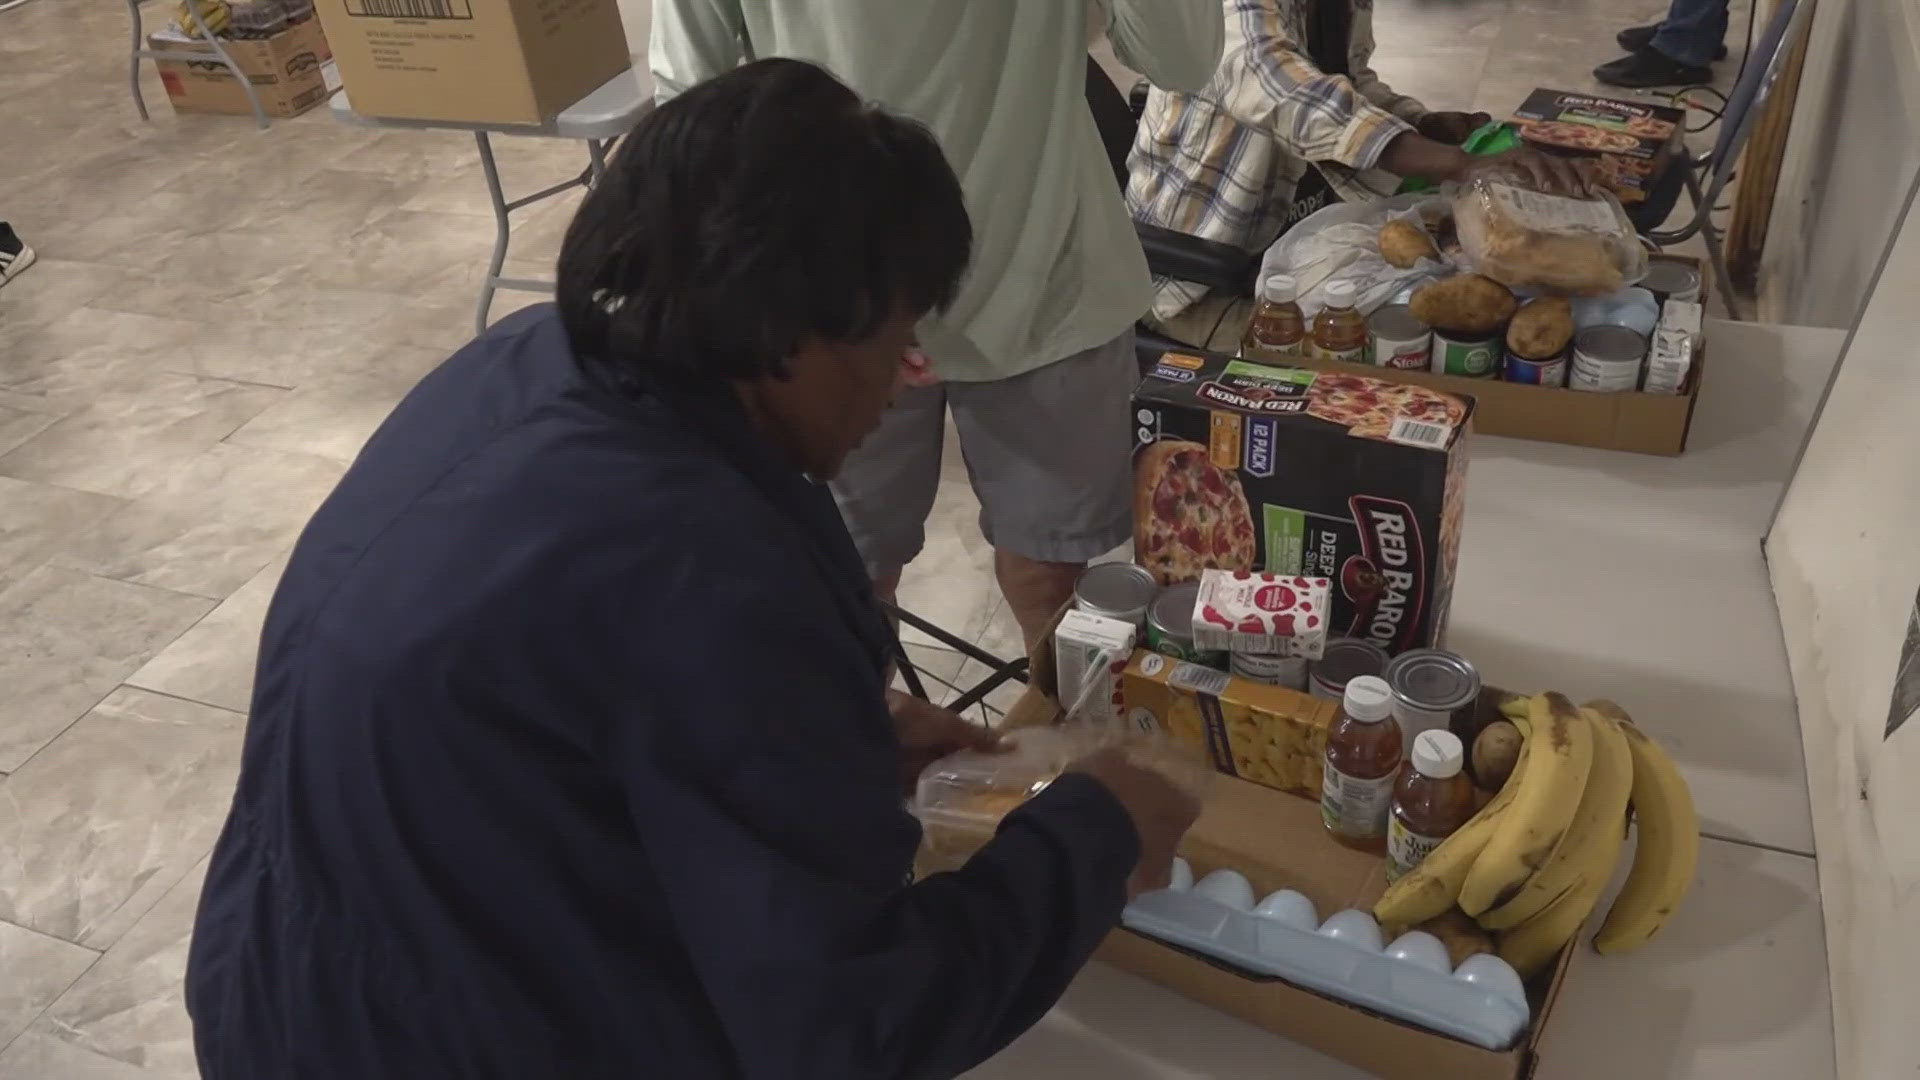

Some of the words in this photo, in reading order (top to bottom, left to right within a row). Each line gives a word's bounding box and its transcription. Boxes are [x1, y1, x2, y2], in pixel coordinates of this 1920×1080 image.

[1205, 387, 1263, 410] BARON
[1264, 400, 1304, 411] RED
[1253, 423, 1269, 437] 12
[1252, 437, 1268, 470] PACK
[1370, 509, 1408, 566] RED
[1319, 530, 1337, 576] DEEP
